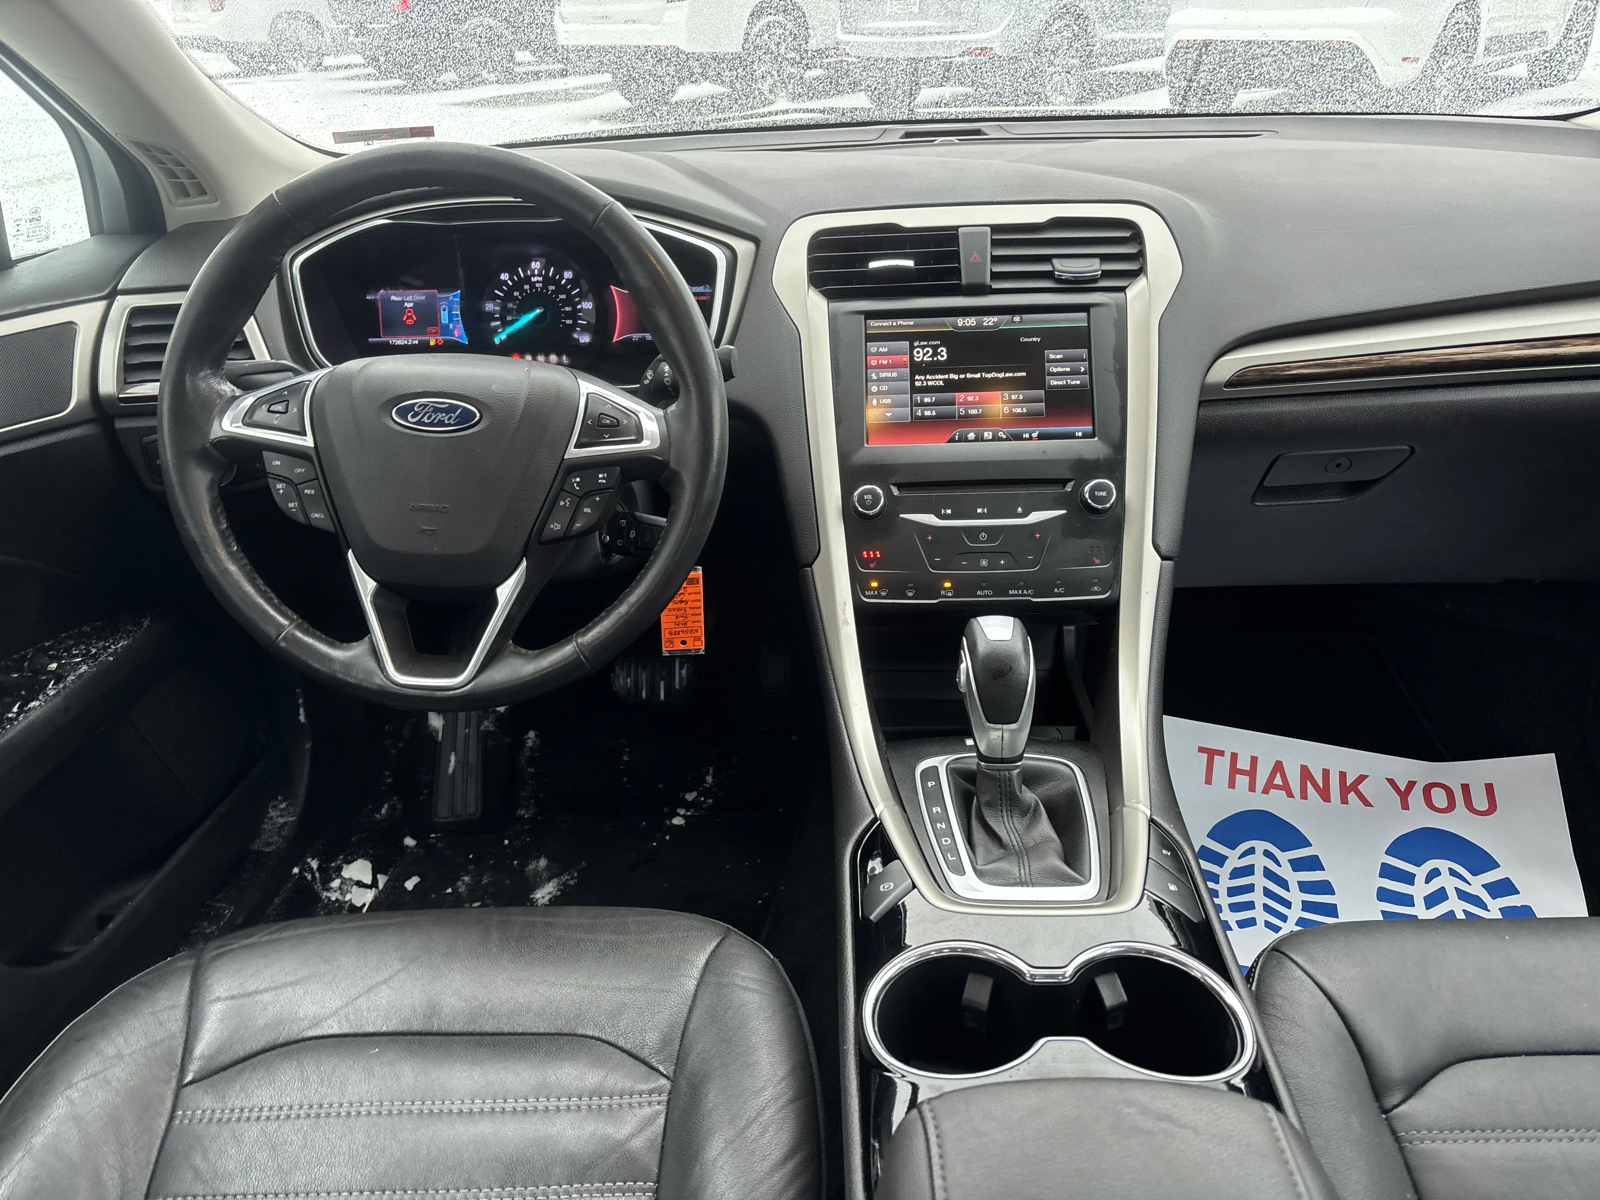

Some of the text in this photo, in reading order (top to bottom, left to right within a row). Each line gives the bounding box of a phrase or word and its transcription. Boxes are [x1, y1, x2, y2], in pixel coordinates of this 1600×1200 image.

[531, 261, 540, 269] 60
[564, 271, 572, 279] 80
[957, 318, 976, 326] 9:05
[913, 347, 948, 362] 92.3
[407, 402, 462, 424] Ford
[1197, 745, 1499, 817] THANK YOU
